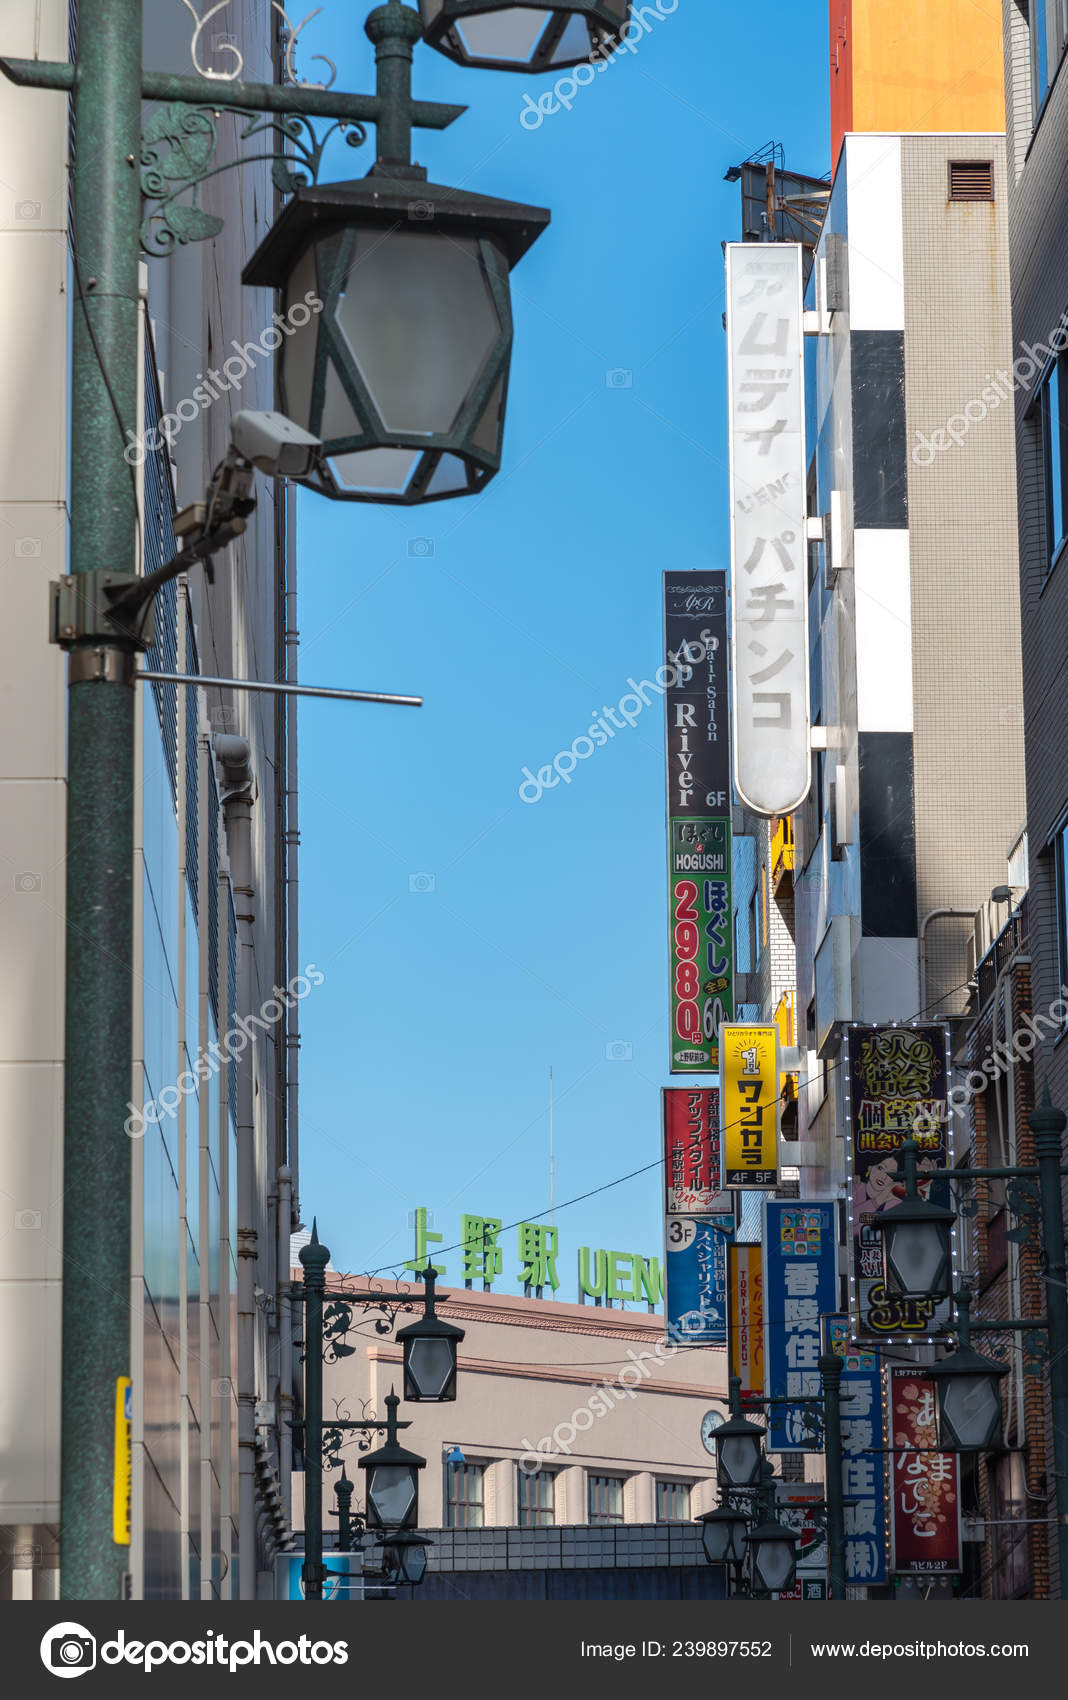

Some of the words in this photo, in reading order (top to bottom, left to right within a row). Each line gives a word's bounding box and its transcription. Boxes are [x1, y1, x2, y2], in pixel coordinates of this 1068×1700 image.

[744, 529, 796, 731] パチンコ
[706, 686, 717, 741] Salon
[673, 703, 698, 807] River
[705, 791, 726, 808] 6F
[676, 854, 724, 870] HOGUSHI
[704, 879, 729, 977] ほぐし
[737, 1080, 763, 1164] ワンカラ
[861, 1132, 939, 1151] 出会い茶
[672, 1138, 685, 1191] 上野駅前店
[732, 1174, 749, 1183] 4F
[755, 1174, 772, 1183] 5F
[404, 1207, 560, 1290] 上野駅
[669, 1221, 692, 1243] 3F
[578, 1246, 664, 1304] UEN
[696, 1230, 712, 1306] スペシャリスト
